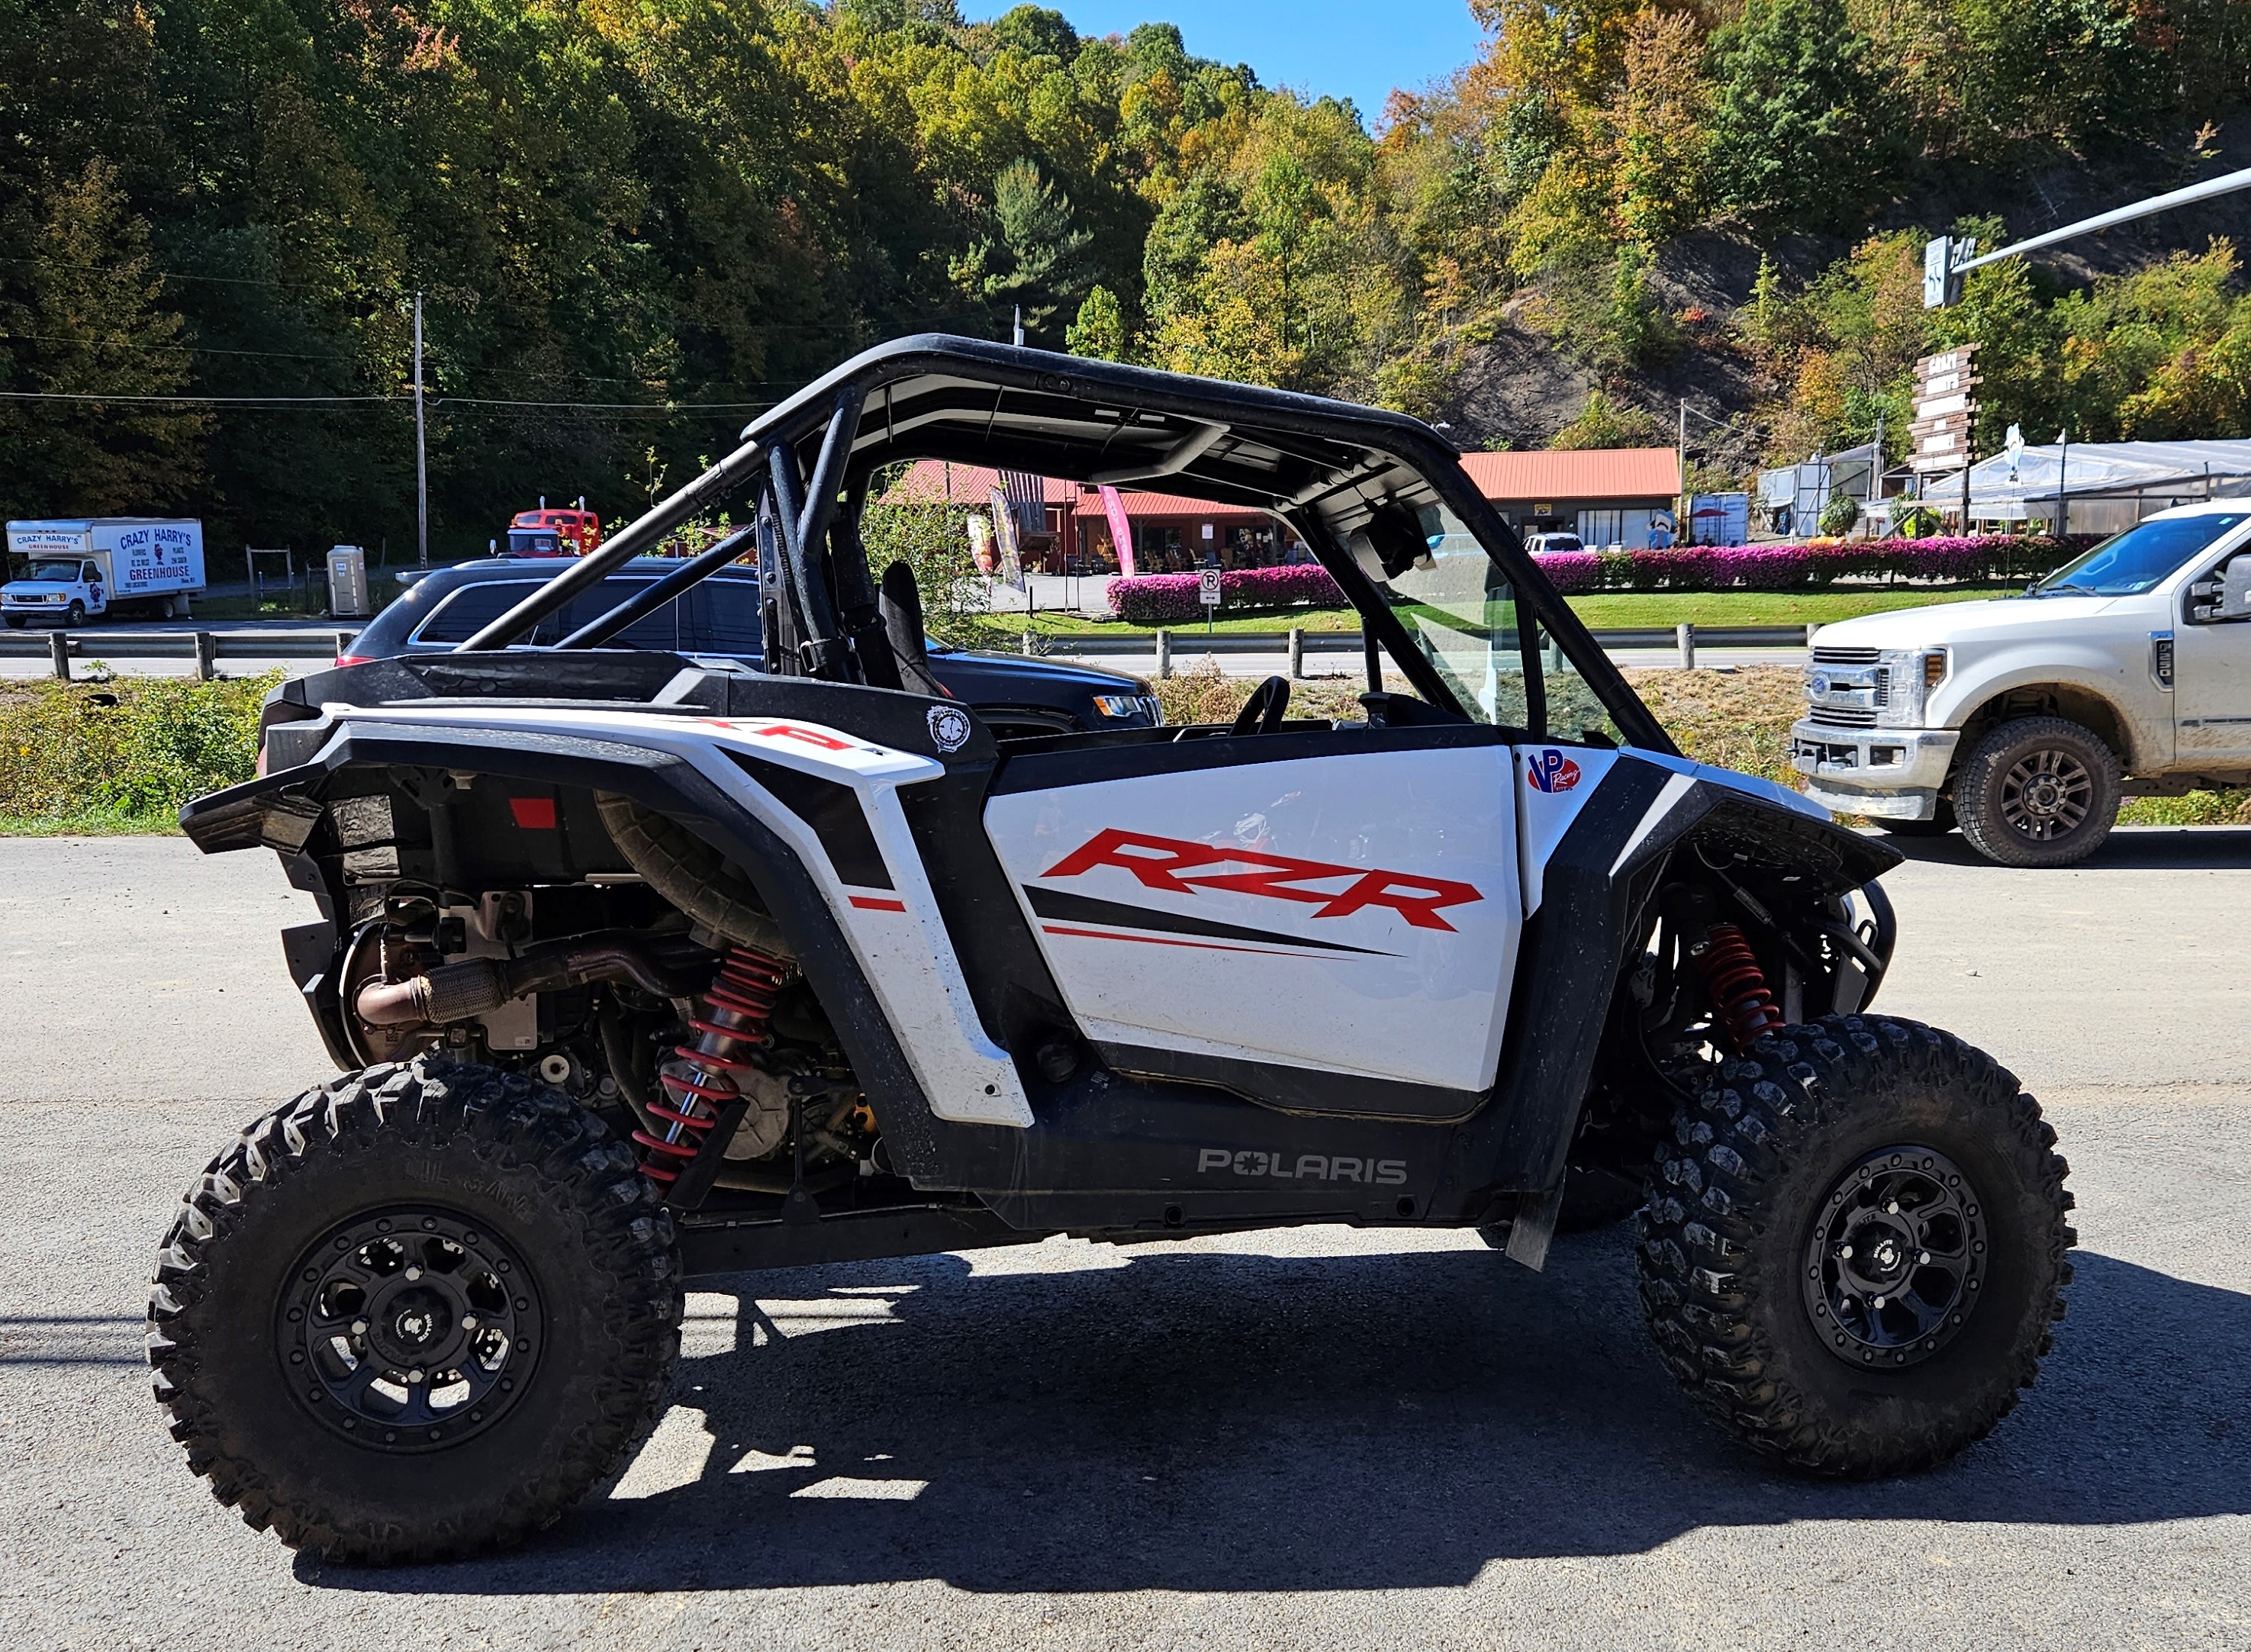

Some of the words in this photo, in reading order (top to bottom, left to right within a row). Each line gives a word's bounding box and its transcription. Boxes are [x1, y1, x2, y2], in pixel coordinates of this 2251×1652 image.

[17, 535, 42, 544] CRAZY
[46, 535, 79, 545] HARRY'S
[120, 529, 149, 550] CRAZY
[154, 529, 192, 546] HARRY'S
[129, 565, 190, 581] GREENHOUSE
[1528, 749, 1563, 793] VP
[1553, 769, 1580, 787] Racing
[1039, 827, 1485, 933] RZR
[1196, 1148, 1407, 1184] POLARIS
